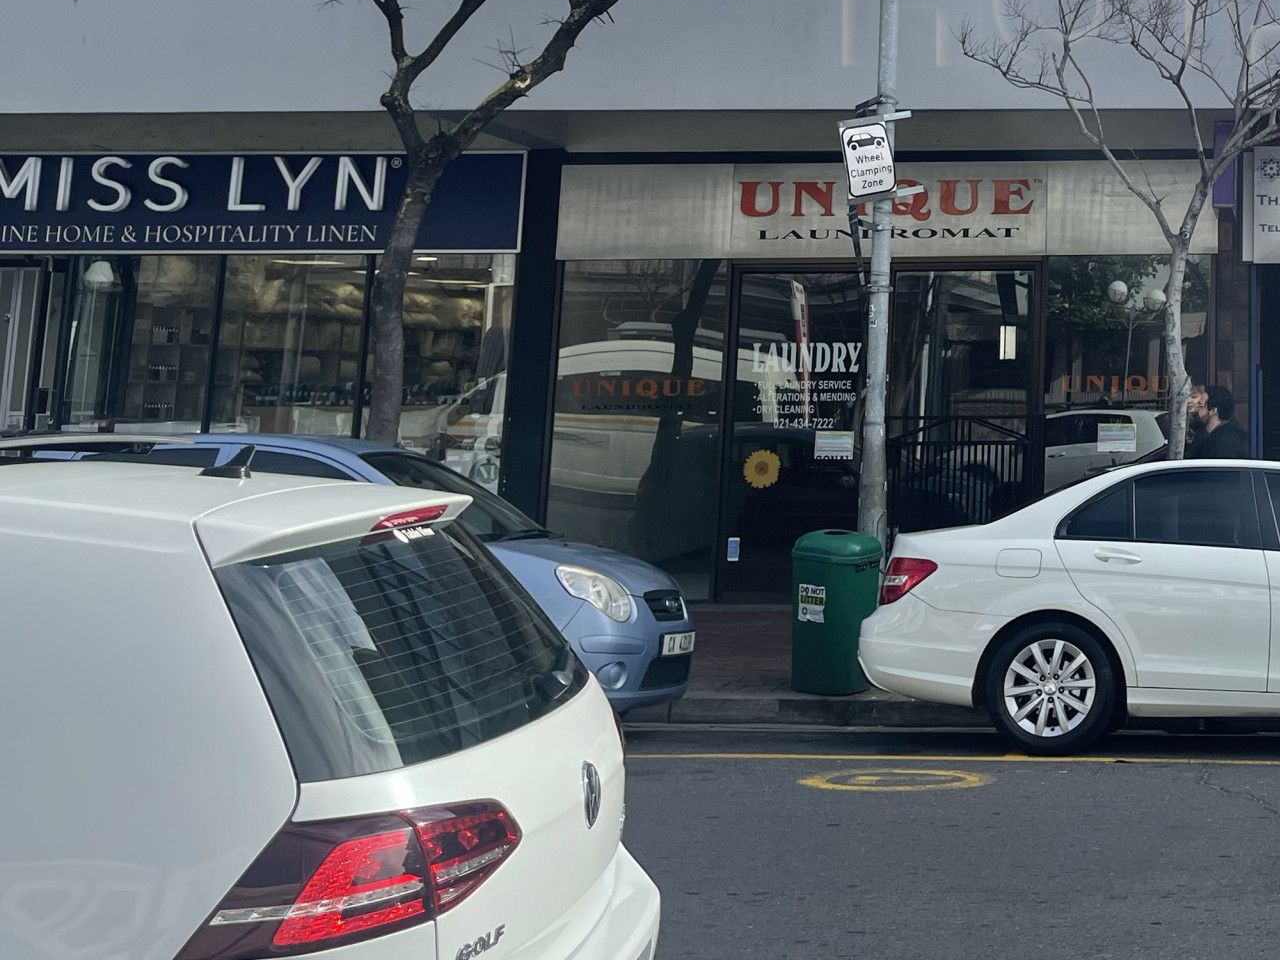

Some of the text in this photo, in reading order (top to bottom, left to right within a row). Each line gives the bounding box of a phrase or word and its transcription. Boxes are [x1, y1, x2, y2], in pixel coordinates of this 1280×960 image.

[855, 152, 884, 164] Wheel
[850, 164, 893, 179] Clamping
[0, 156, 190, 212] MISS
[861, 178, 884, 190] Zone
[44, 224, 114, 243] HOME
[121, 225, 136, 242] &
[144, 224, 301, 243] HOSPITALITY
[305, 224, 377, 243] LINEN
[752, 342, 863, 373] LAUNDRY
[571, 378, 706, 399] UNIQUE
[757, 380, 852, 390] FU LAUNDRY SERVICE
[1062, 374, 1172, 396] UNIQU
[757, 392, 857, 402] ALTERATIONS & MENDING
[775, 404, 815, 414] CLEANING
[773, 418, 834, 429] 021-434-7222
[800, 586, 825, 596] DO NOT
[456, 923, 506, 960] GOLF
